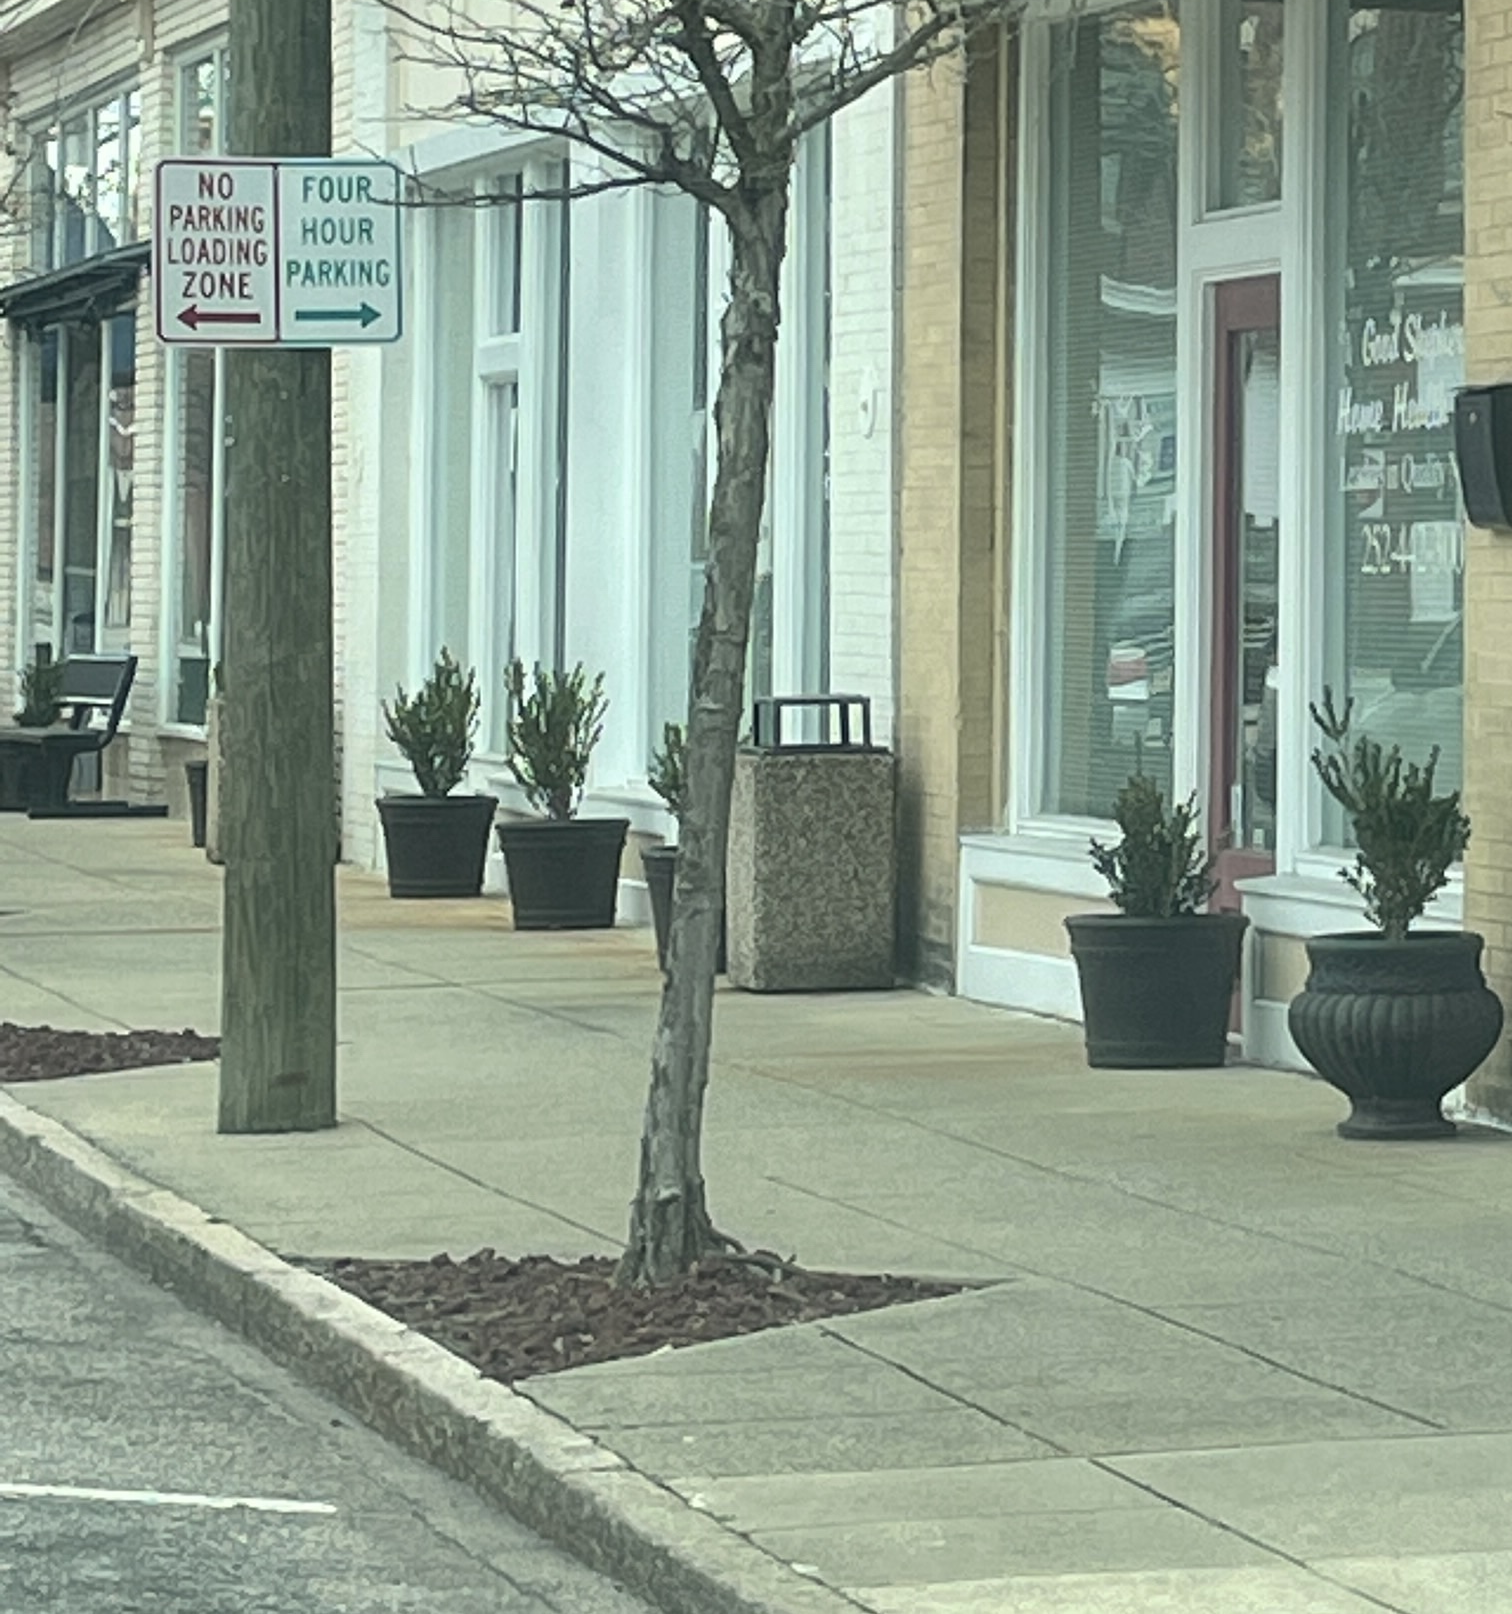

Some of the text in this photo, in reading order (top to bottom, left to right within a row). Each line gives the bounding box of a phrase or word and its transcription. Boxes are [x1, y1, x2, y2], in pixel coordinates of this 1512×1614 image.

[198, 172, 234, 200] NO
[302, 176, 372, 204] FOUR
[170, 205, 265, 233] PARKING
[301, 218, 374, 245] HOUR
[168, 238, 268, 266] LOADING
[182, 272, 253, 300] ZONE
[286, 259, 391, 287] PARKING
[1361, 311, 1401, 366] Good
[1336, 386, 1384, 434] Home
